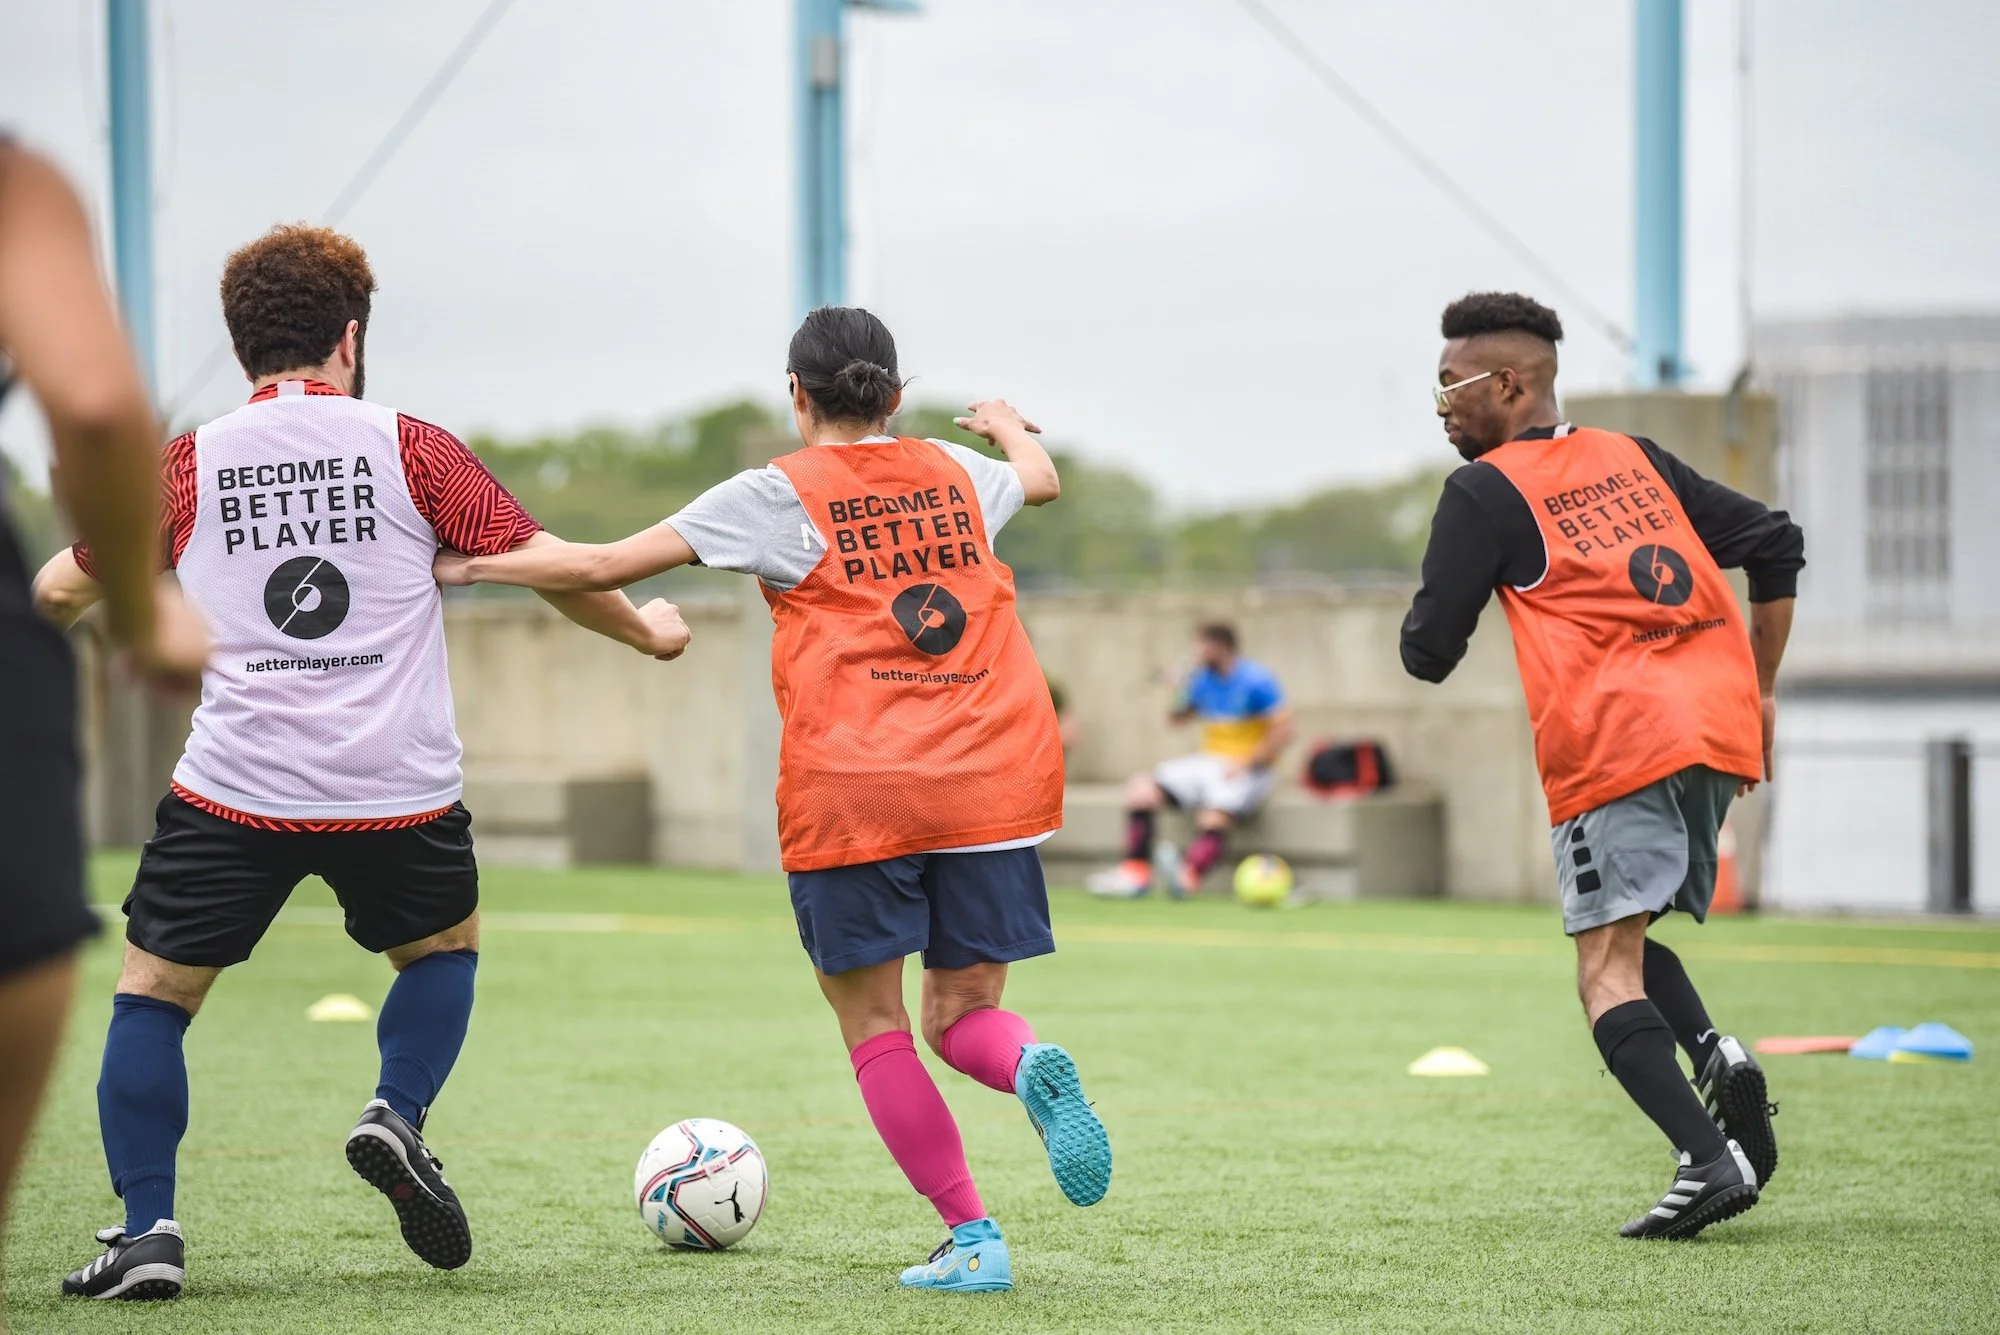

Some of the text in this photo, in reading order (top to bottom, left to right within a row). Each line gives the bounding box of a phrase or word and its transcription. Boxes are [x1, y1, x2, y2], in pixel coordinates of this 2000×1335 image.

[217, 456, 373, 491] BECOME A
[1544, 468, 1650, 516] BECOME A
[220, 484, 375, 523] BETTER
[828, 484, 966, 523] BECOME A
[1557, 486, 1665, 539] BETTER
[225, 516, 377, 555] PLAYER
[836, 511, 973, 554] BETTER
[1574, 508, 1679, 558] PLAYER
[844, 541, 981, 584] PLAYER
[246, 653, 383, 673] betterplayer.com
